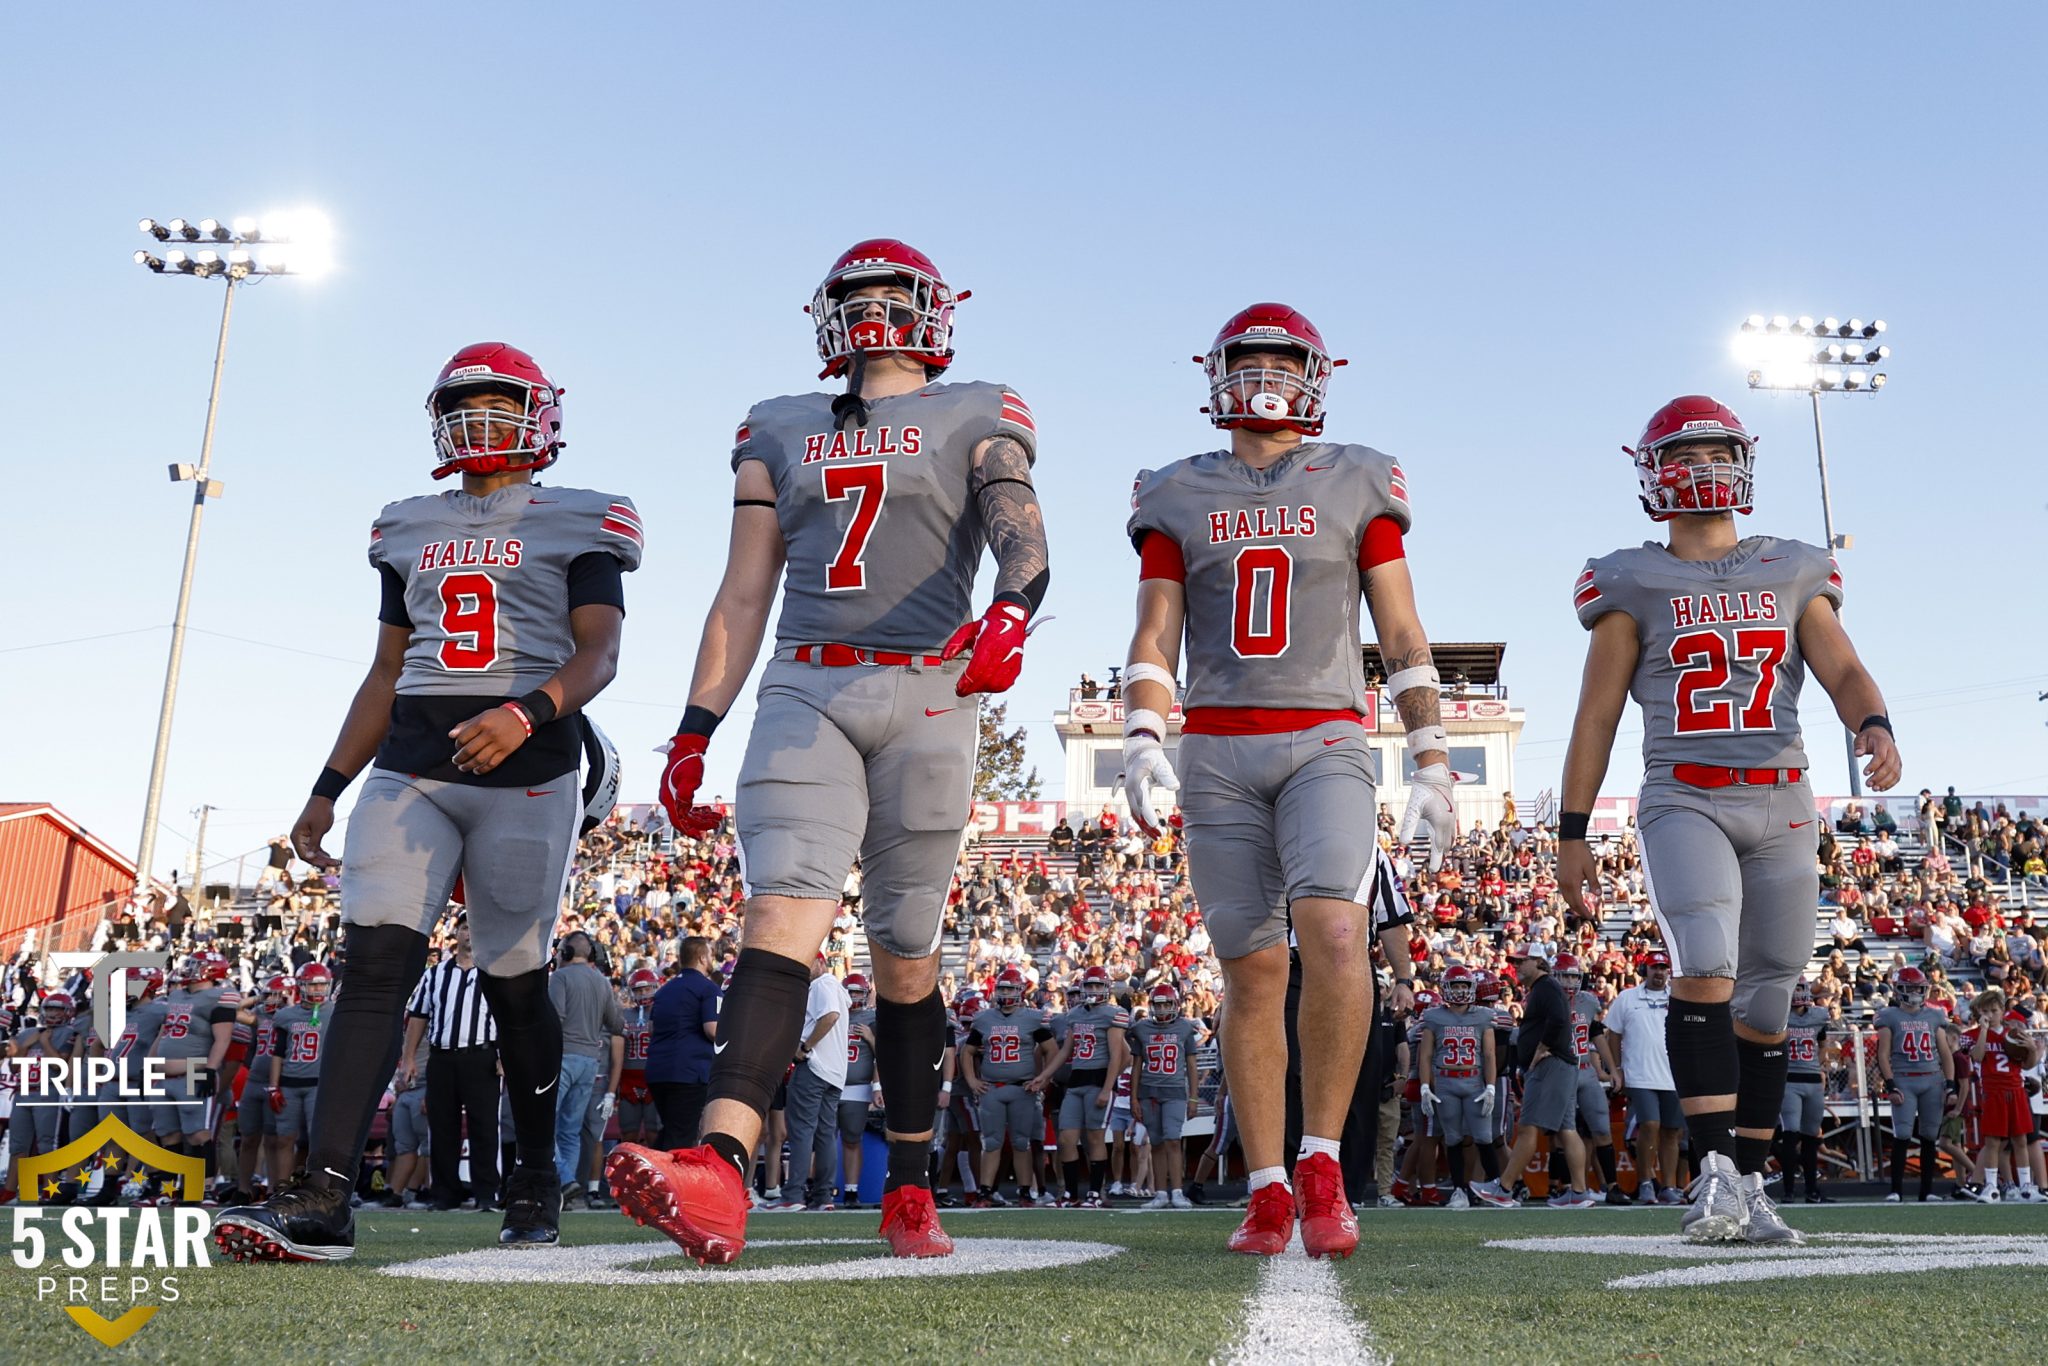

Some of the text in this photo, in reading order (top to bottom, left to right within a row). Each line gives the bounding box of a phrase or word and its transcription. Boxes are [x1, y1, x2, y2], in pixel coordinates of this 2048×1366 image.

[1686, 421, 1719, 429] Riddell
[801, 426, 922, 466] HALLS
[822, 461, 888, 592] 7
[1208, 505, 1317, 544] HALLS
[418, 538, 523, 572] HALLS
[1230, 545, 1293, 659] 0
[1670, 591, 1777, 629] HALLS
[437, 571, 499, 671] 9
[1668, 627, 1789, 735] 27
[289, 1031, 320, 1062] 19
[1444, 1026, 1474, 1036] HALLS
[1902, 1031, 1934, 1062] 44
[988, 1034, 1021, 1063] 62
[1146, 1043, 1178, 1074] 58
[1442, 1036, 1477, 1066] 33
[1788, 1038, 1814, 1061] 13
[1995, 1054, 2010, 1073] 2
